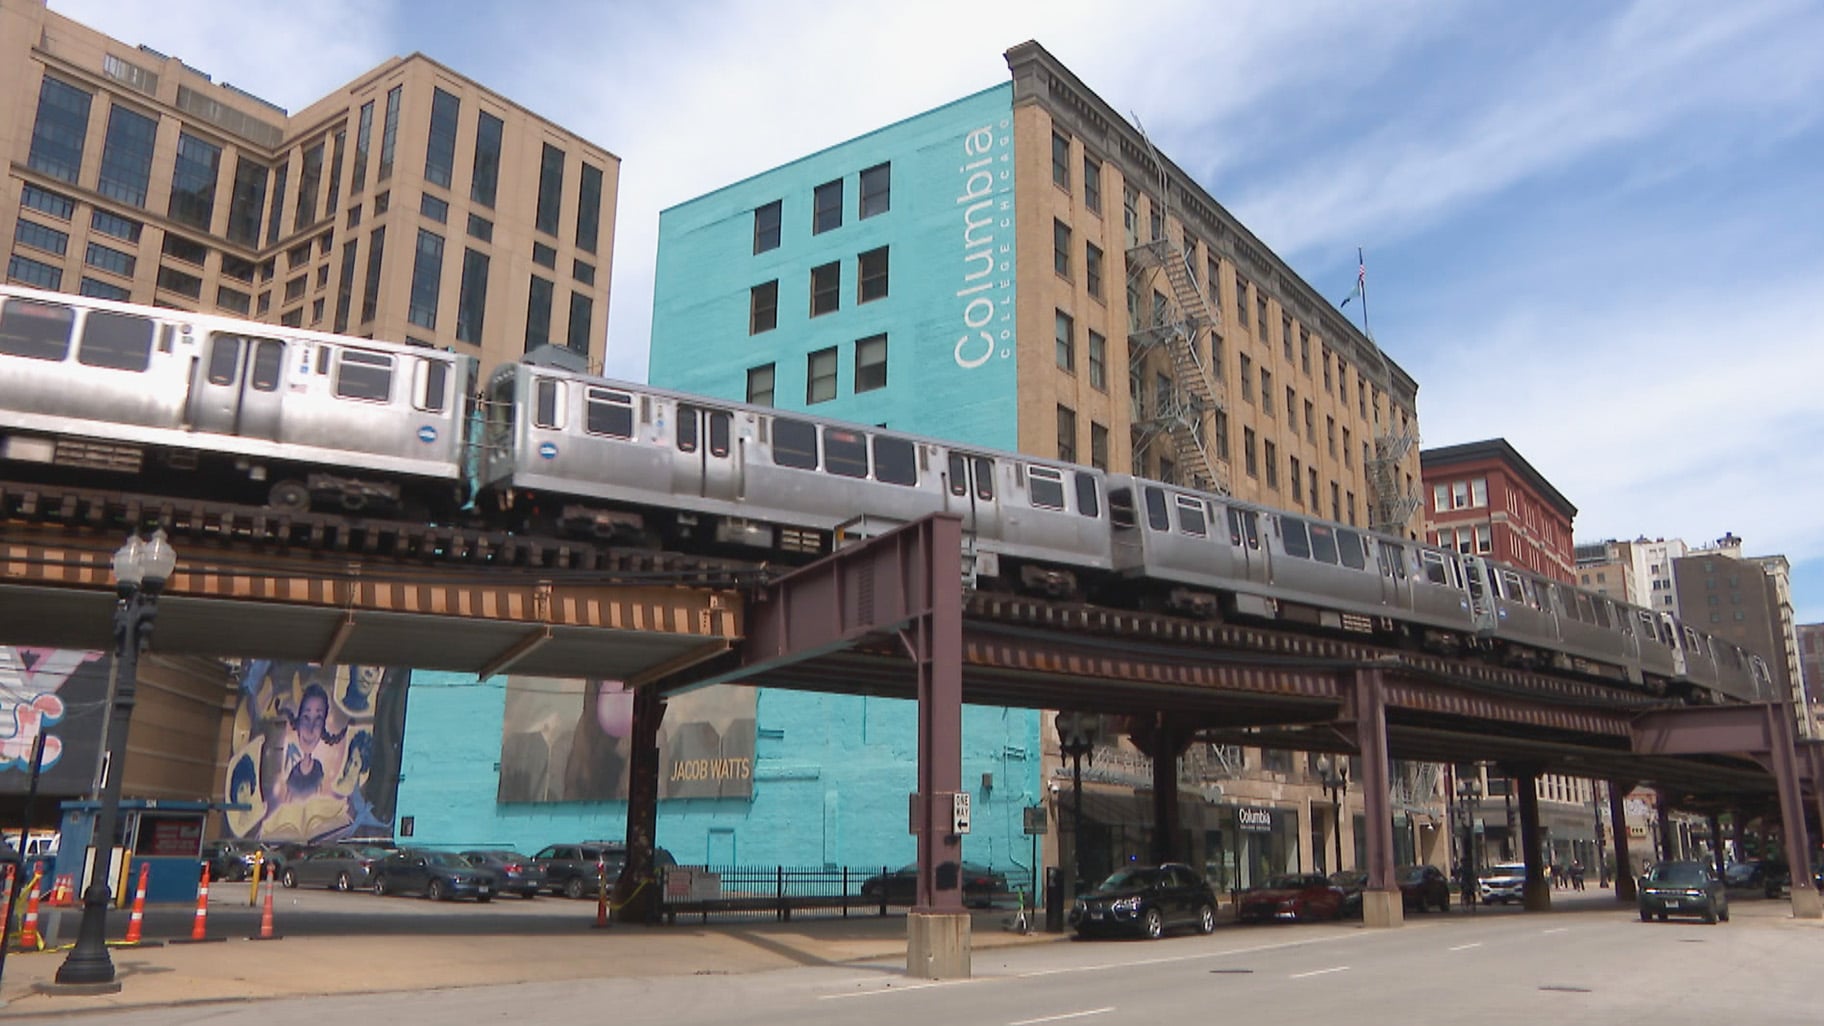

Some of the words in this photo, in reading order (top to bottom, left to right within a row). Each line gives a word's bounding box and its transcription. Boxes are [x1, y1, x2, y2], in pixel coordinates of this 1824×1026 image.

[999, 118, 1010, 228] CHICAGO
[954, 122, 995, 369] Columbia
[1000, 243, 1011, 359] COLLEGE
[670, 759, 708, 781] JACOB
[710, 757, 750, 780] WATTS
[956, 795, 969, 806] ONE
[956, 807, 969, 816] WAY
[1239, 807, 1271, 825] Columbia
